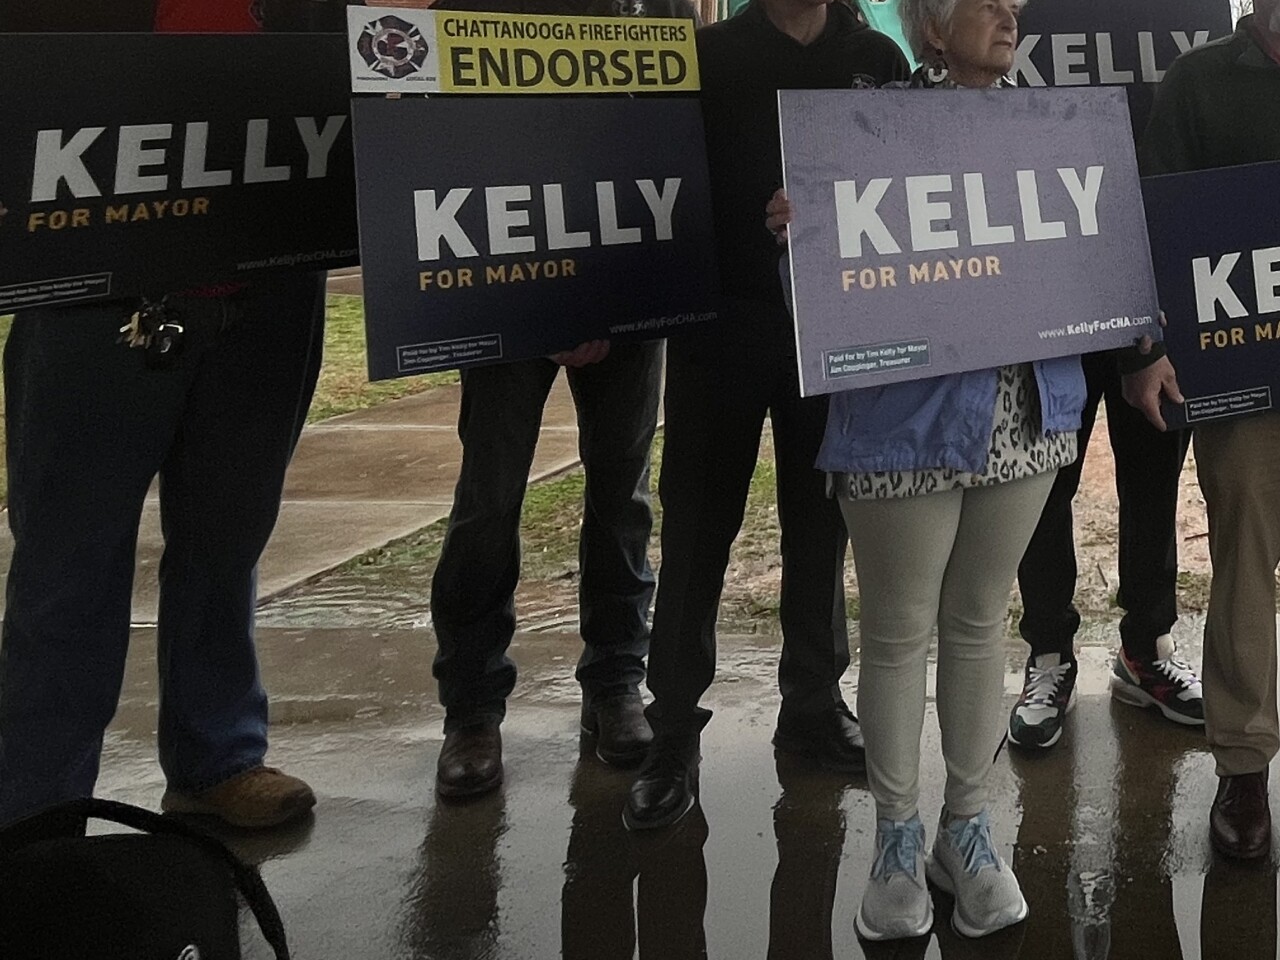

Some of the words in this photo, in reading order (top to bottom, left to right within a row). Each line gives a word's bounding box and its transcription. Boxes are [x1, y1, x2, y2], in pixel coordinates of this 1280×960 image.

[443, 19, 575, 41] CHATTANOOGA
[579, 24, 687, 41] FIREFIGHTERS
[450, 47, 687, 87] ENDORSED
[30, 115, 347, 202] KELLY
[27, 208, 91, 232] FOR
[105, 197, 210, 224] MAYOR
[414, 178, 681, 261] KELLY
[834, 166, 1104, 258] KELLY
[419, 268, 474, 291] FOR
[485, 259, 577, 285] MAYOR
[841, 266, 897, 291] FOR
[908, 256, 1001, 284] MAYOR
[1038, 316, 1152, 339] www.KellyForCHA.com
[1200, 327, 1245, 350] FOR
